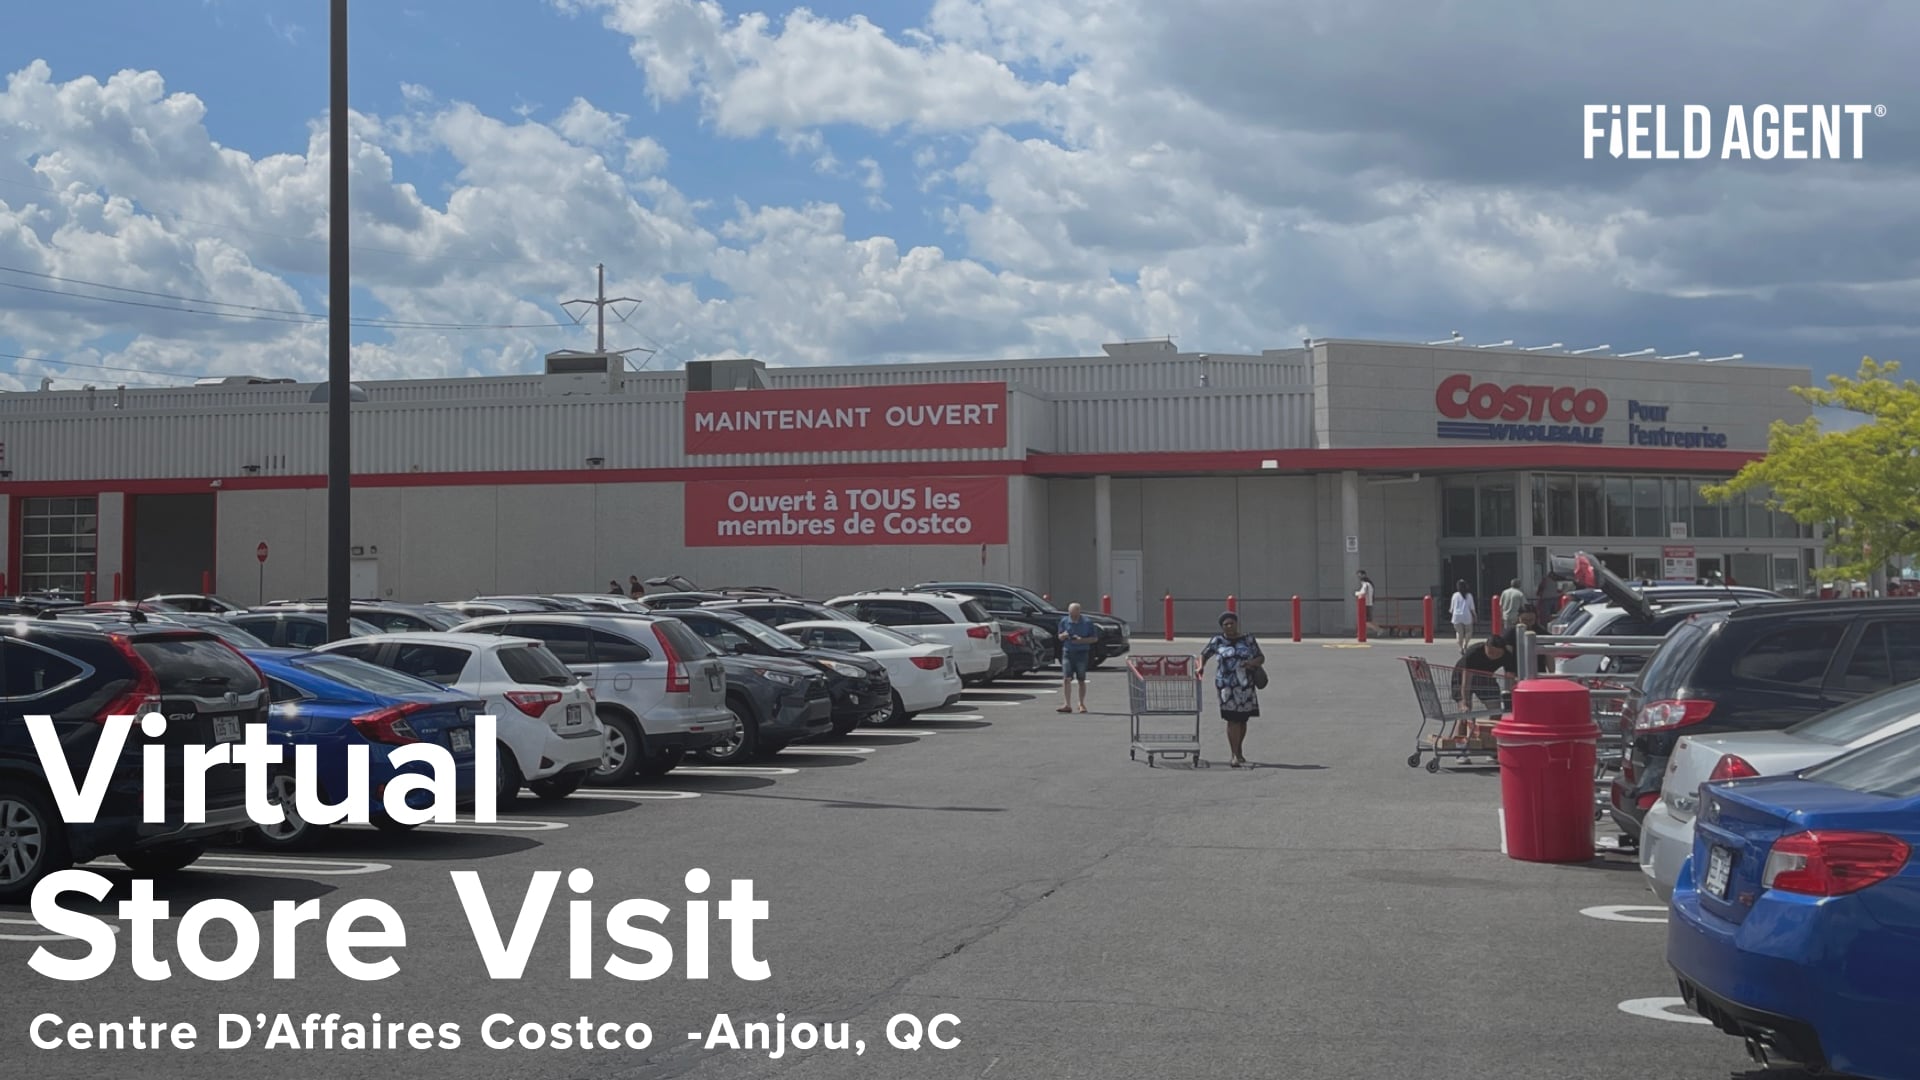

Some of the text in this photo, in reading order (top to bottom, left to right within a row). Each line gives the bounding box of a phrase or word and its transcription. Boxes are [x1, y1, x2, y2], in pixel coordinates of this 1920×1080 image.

[1435, 374, 1608, 424] COSTCO
[1628, 399, 1670, 422] Pour
[695, 403, 999, 432] MAINTENANT OUVERT
[1488, 423, 1604, 444] WHOLESALE
[1628, 423, 1728, 449] l'entreprise
[728, 487, 961, 513] Ouvert à TOUS les
[717, 511, 972, 536] membres de Costco
